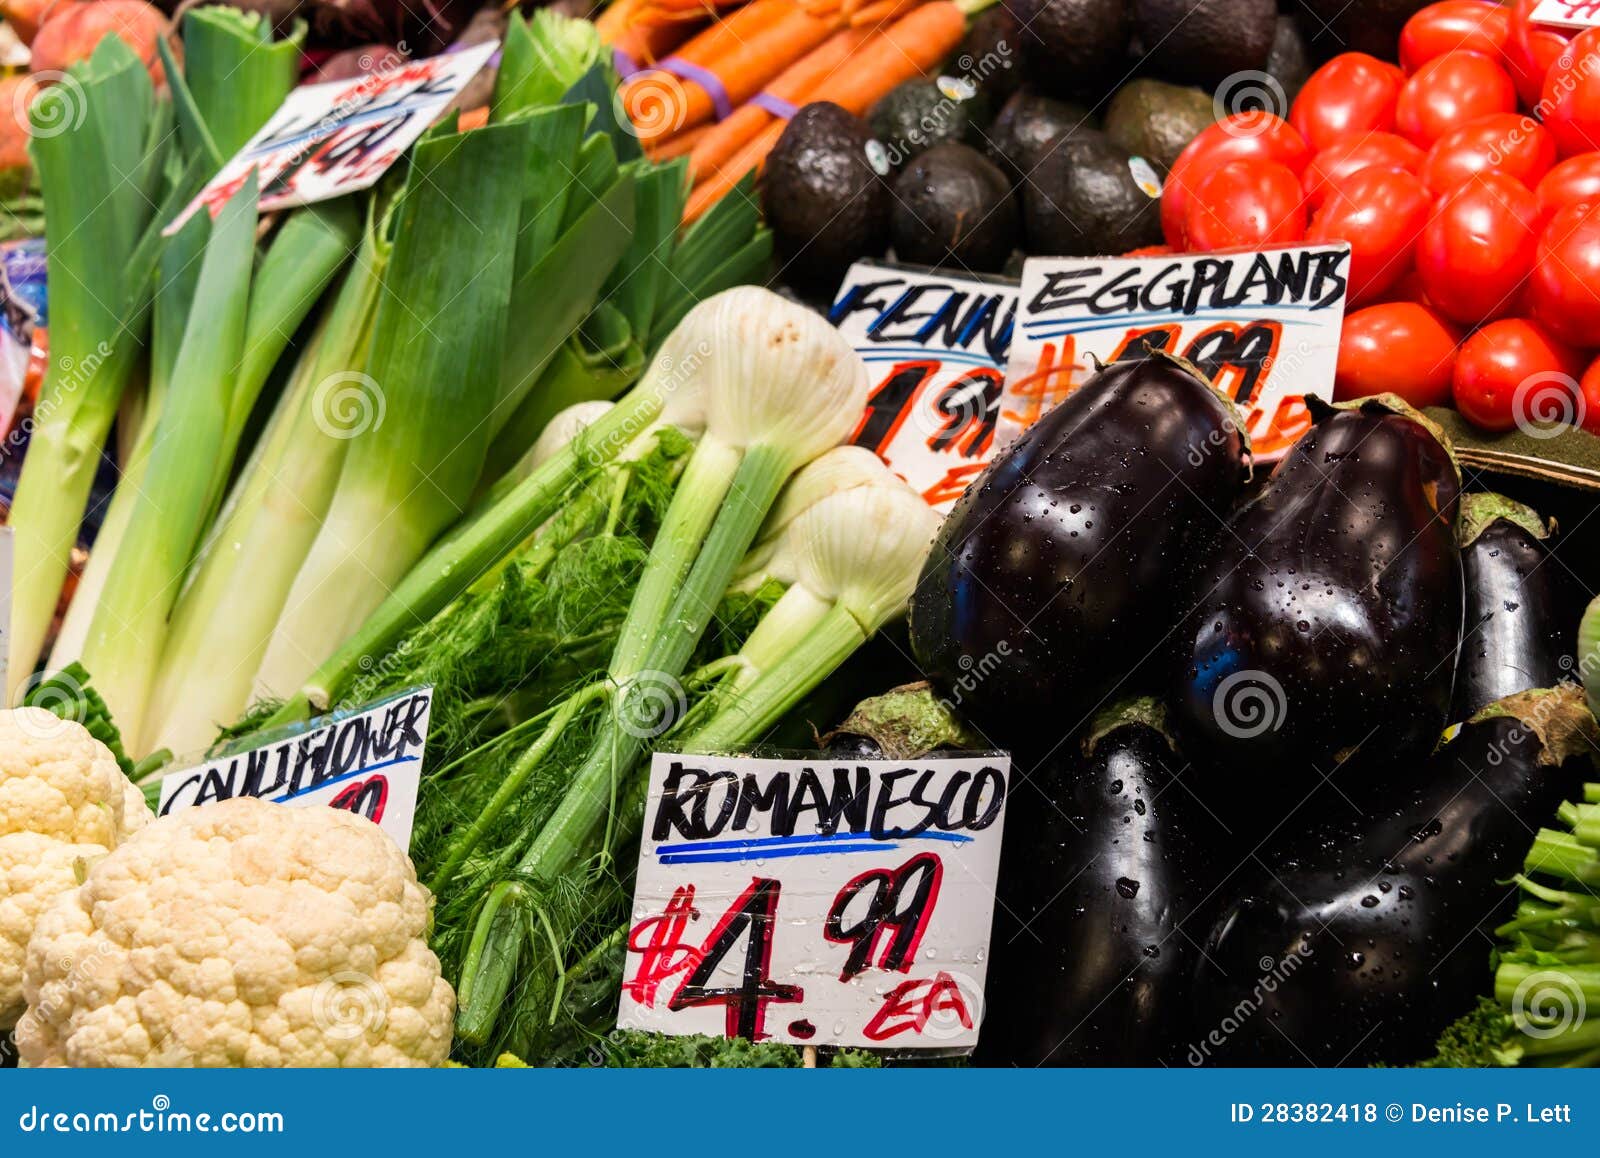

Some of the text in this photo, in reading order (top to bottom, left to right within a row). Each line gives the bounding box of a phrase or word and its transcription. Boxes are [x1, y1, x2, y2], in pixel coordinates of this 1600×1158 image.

[827, 279, 1019, 365] FENN
[159, 694, 430, 817] CAULIFLOWER
[652, 762, 1006, 840] ROMANESCO
[863, 971, 973, 1041] EA
